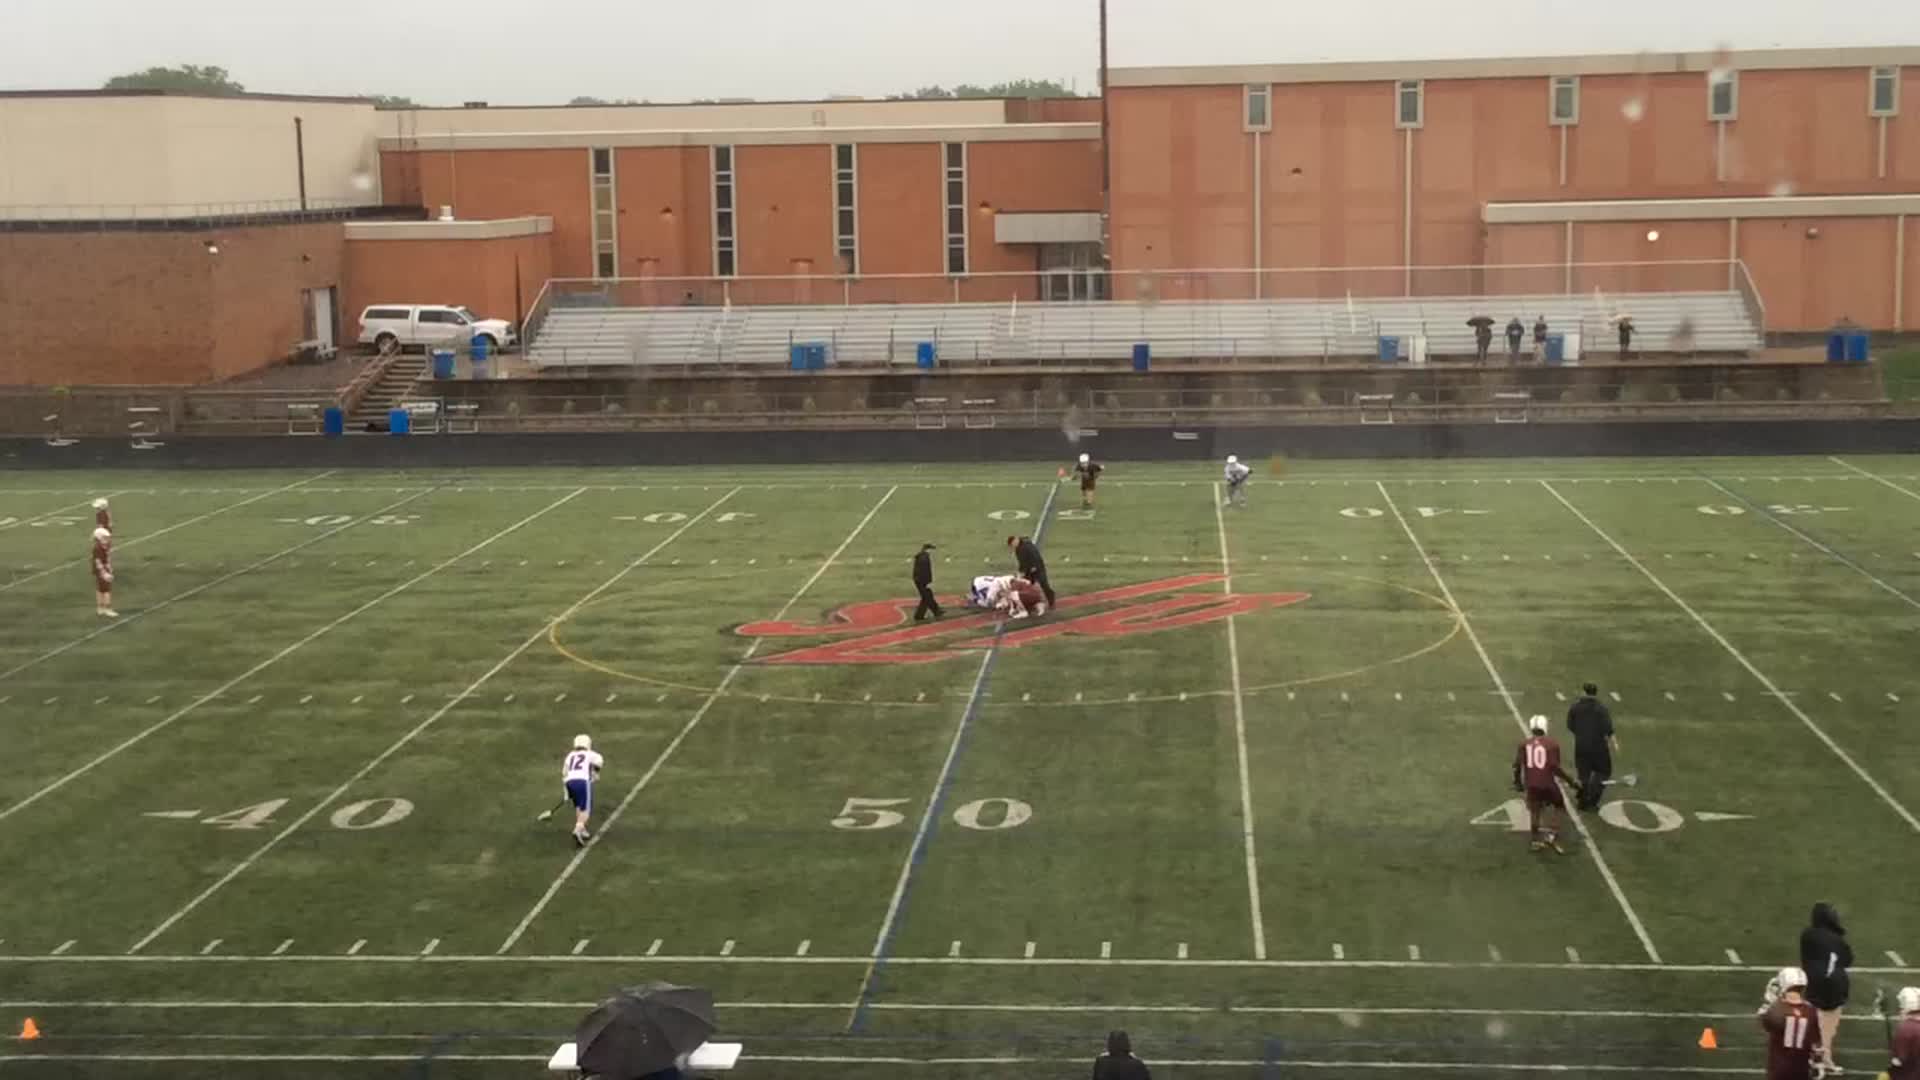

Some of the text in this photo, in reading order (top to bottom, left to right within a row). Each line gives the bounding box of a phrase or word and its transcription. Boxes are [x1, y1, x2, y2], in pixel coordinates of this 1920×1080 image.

[569, 754, 586, 772] 12
[1525, 744, 1547, 769] 10
[199, 798, 415, 830] 40
[830, 797, 1033, 831] 50
[1783, 1015, 1808, 1049] 11
